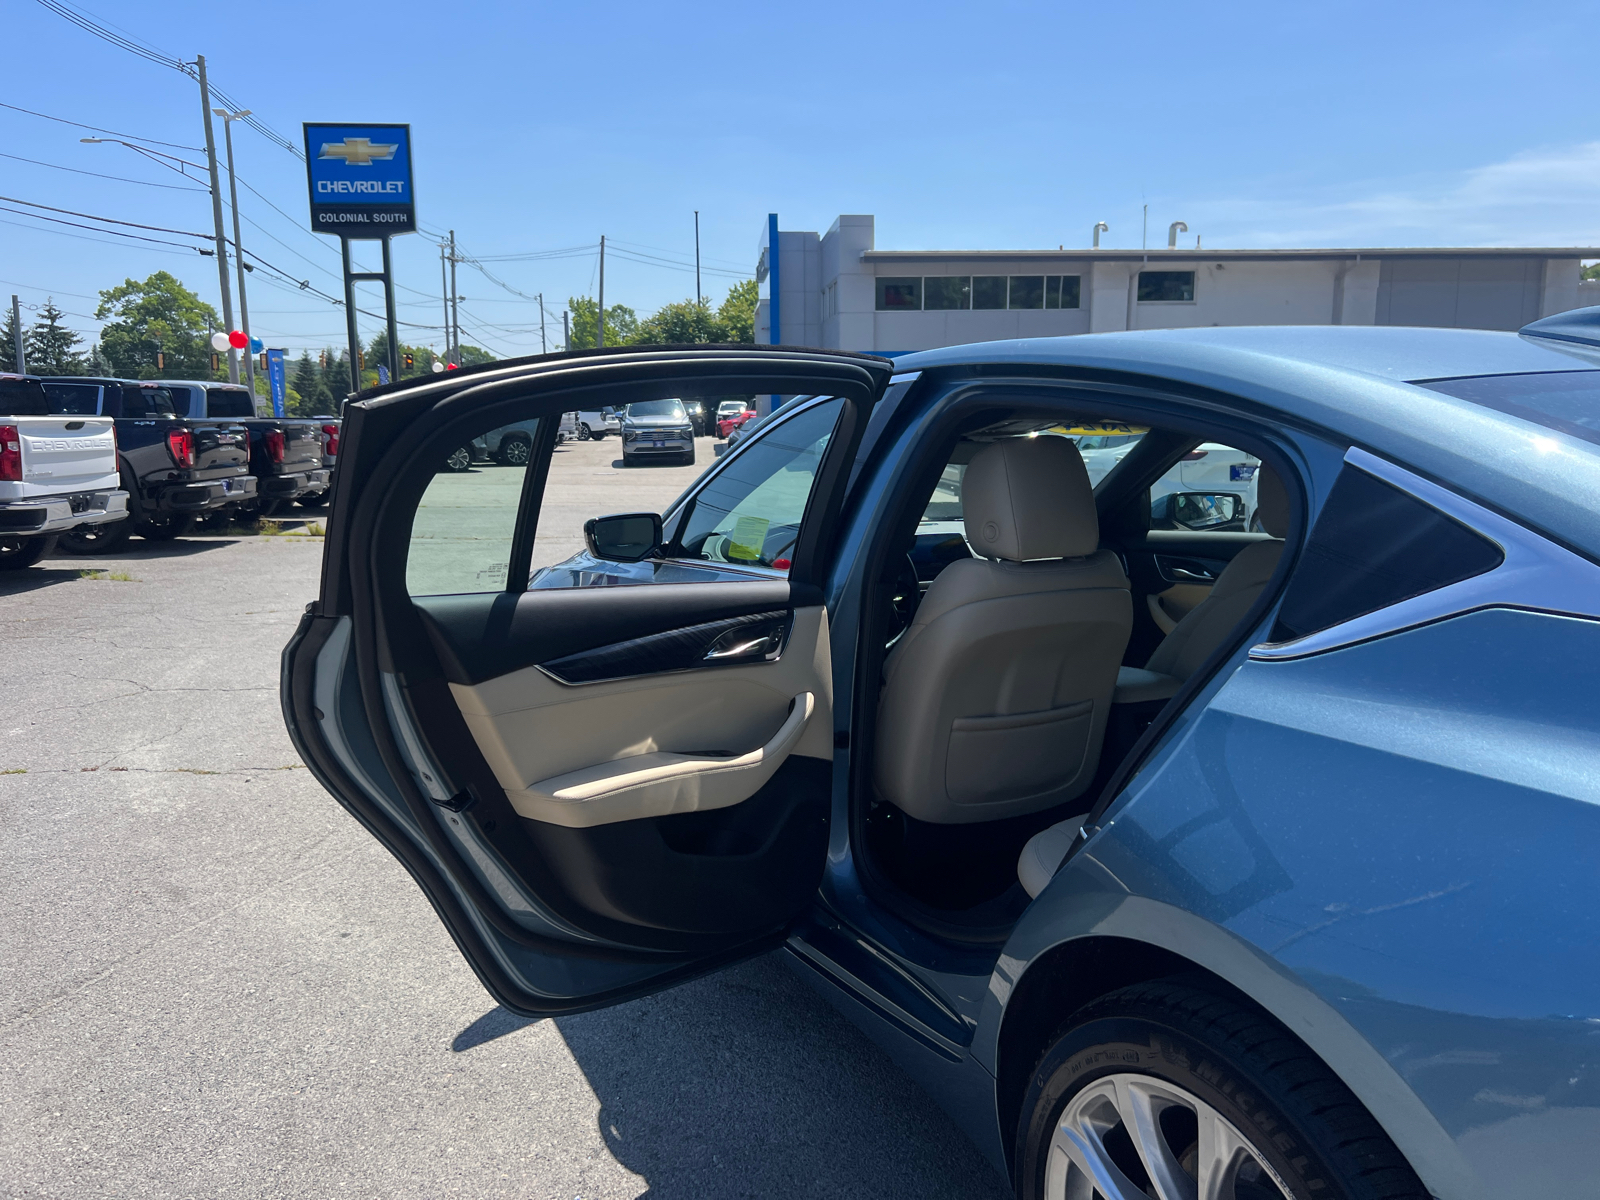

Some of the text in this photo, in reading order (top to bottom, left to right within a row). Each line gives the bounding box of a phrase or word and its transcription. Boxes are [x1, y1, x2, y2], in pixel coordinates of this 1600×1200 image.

[317, 180, 404, 193] CHEVROLET
[319, 213, 407, 222] COLONIAL SOUTH
[31, 439, 113, 452] CHEVROLET
[1195, 1058, 1332, 1200] MICHELI
